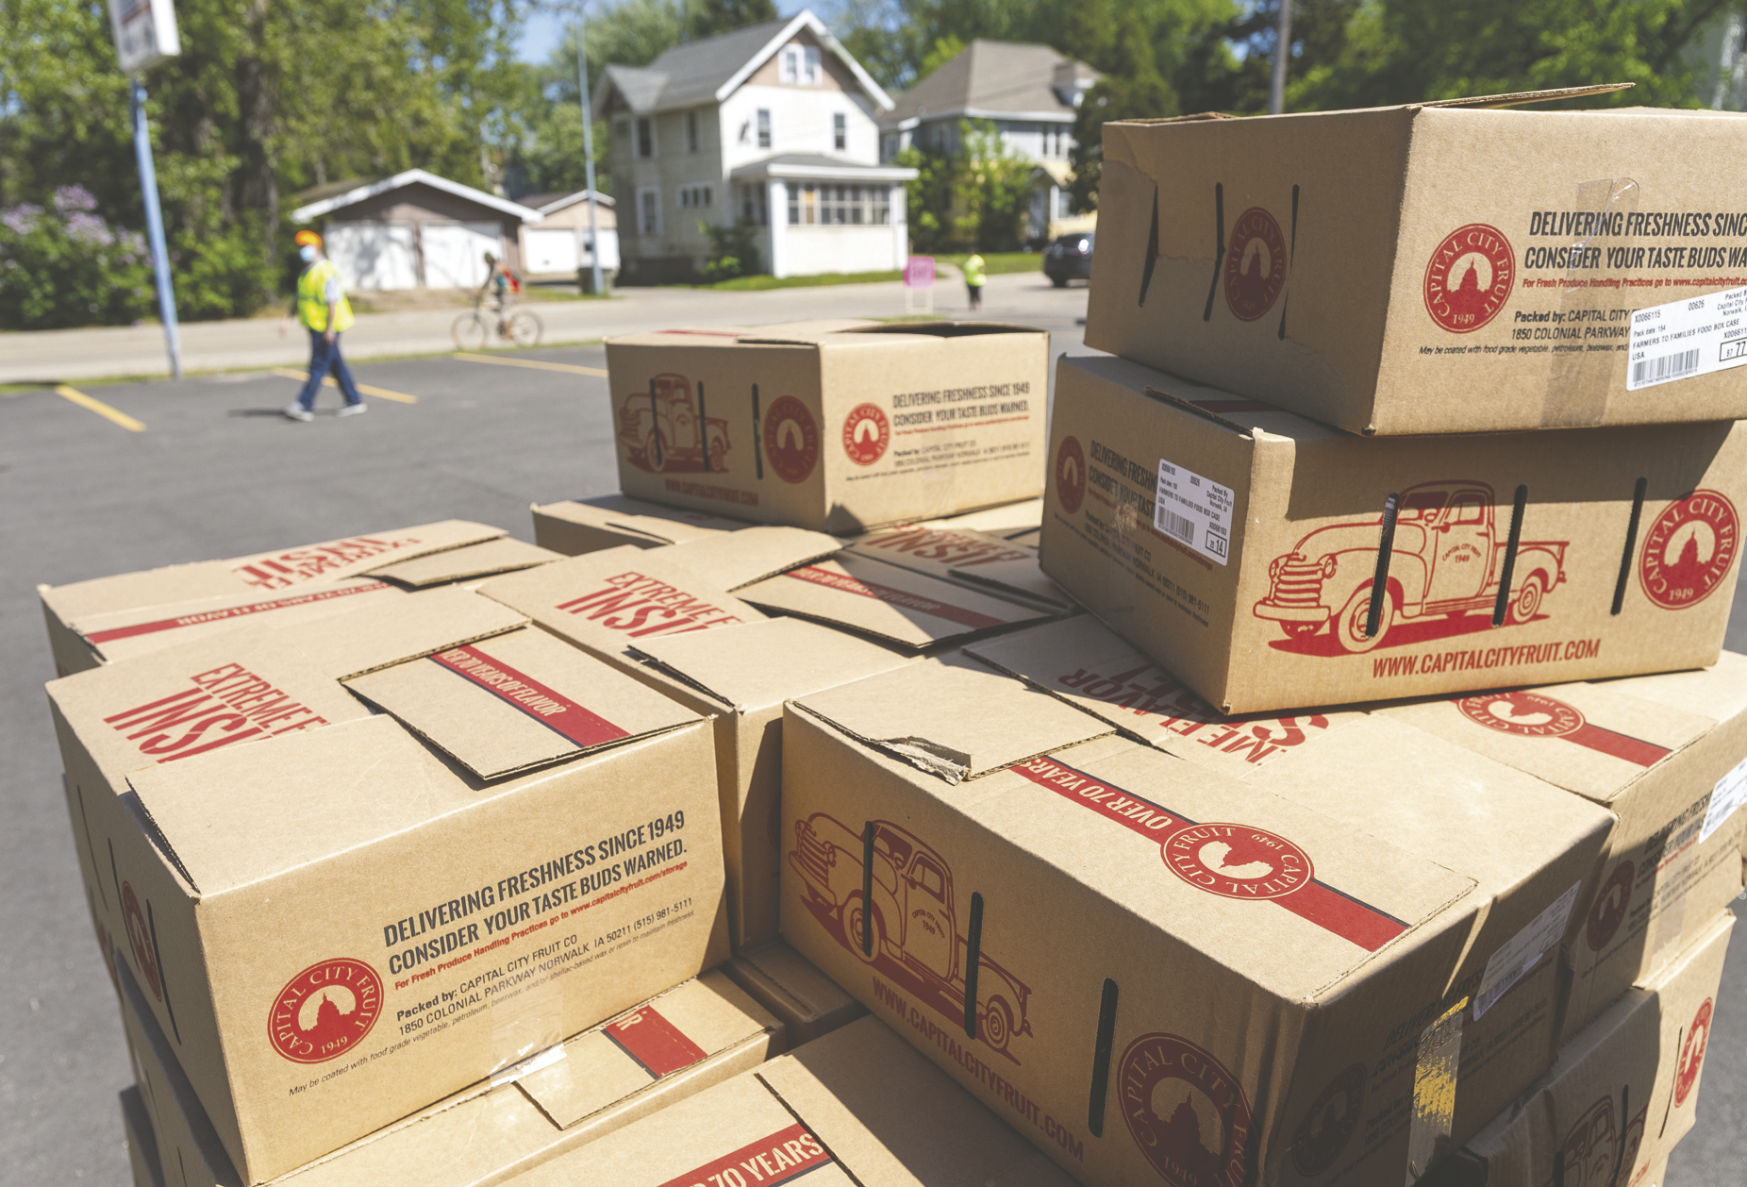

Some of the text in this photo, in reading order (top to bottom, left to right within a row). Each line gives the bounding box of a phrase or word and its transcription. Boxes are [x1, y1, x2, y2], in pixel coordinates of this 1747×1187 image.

[1529, 211, 1624, 237] DELIVERING
[1624, 212, 1712, 237] FRESHNESS
[1430, 231, 1509, 317] CAPITAL CITY FRUIT
[1522, 278, 1535, 288] For
[1524, 246, 1601, 269] CONSIDER
[1607, 246, 1645, 269] YOUR
[1647, 247, 1686, 269] TASTE
[1686, 247, 1726, 269] BUDS
[1453, 313, 1475, 325] 1949
[1512, 326, 1630, 340] 1850 COLONIAL PARKWAY
[1514, 309, 1630, 325] Packed by: CAPITAL CITY
[1646, 498, 1733, 595] CAPITAL CITY FRUIT
[604, 571, 727, 620] EXTREME
[1373, 638, 1601, 679] WWW.CAPITALCITYFRUIT.COM
[190, 662, 313, 730] EXTREME
[1078, 784, 1116, 805] 70
[1106, 796, 1173, 830] OVER
[1173, 827, 1302, 894] CAPITAL CITY FRUIT
[1251, 833, 1285, 851] 1949
[383, 810, 685, 948] DELIVERING FRESHNESS SINCE 1949
[389, 838, 688, 976] CONSIDER YOUR TASTE BUDS WARNED.
[394, 979, 410, 991] For
[411, 967, 436, 984] Fresh
[437, 952, 473, 973] Produce
[473, 936, 510, 957] Handling
[511, 919, 548, 941] Practices
[549, 916, 560, 927] go
[561, 910, 569, 919] to
[400, 897, 694, 1037] 1850 COLONIAL PARKWAY NORWALK IA 50211 (515) 981-5111
[396, 934, 578, 1022] Packed by: CAPITAL CITY FRUIT CO
[276, 966, 377, 1056] CAPITAL CITY FRUIT
[289, 1083, 308, 1097] May
[309, 1078, 320, 1088] be
[321, 1064, 349, 1083] coated
[350, 1056, 368, 1071] with
[370, 1047, 388, 1061] food
[389, 1038, 411, 1054] grade
[321, 1036, 349, 1055] 1949
[872, 975, 1085, 1163] WWW.CAPITALCITYFRUIT.COM
[1127, 1046, 1173, 1147] CAPITAL
[740, 1133, 825, 1181] YEARS
